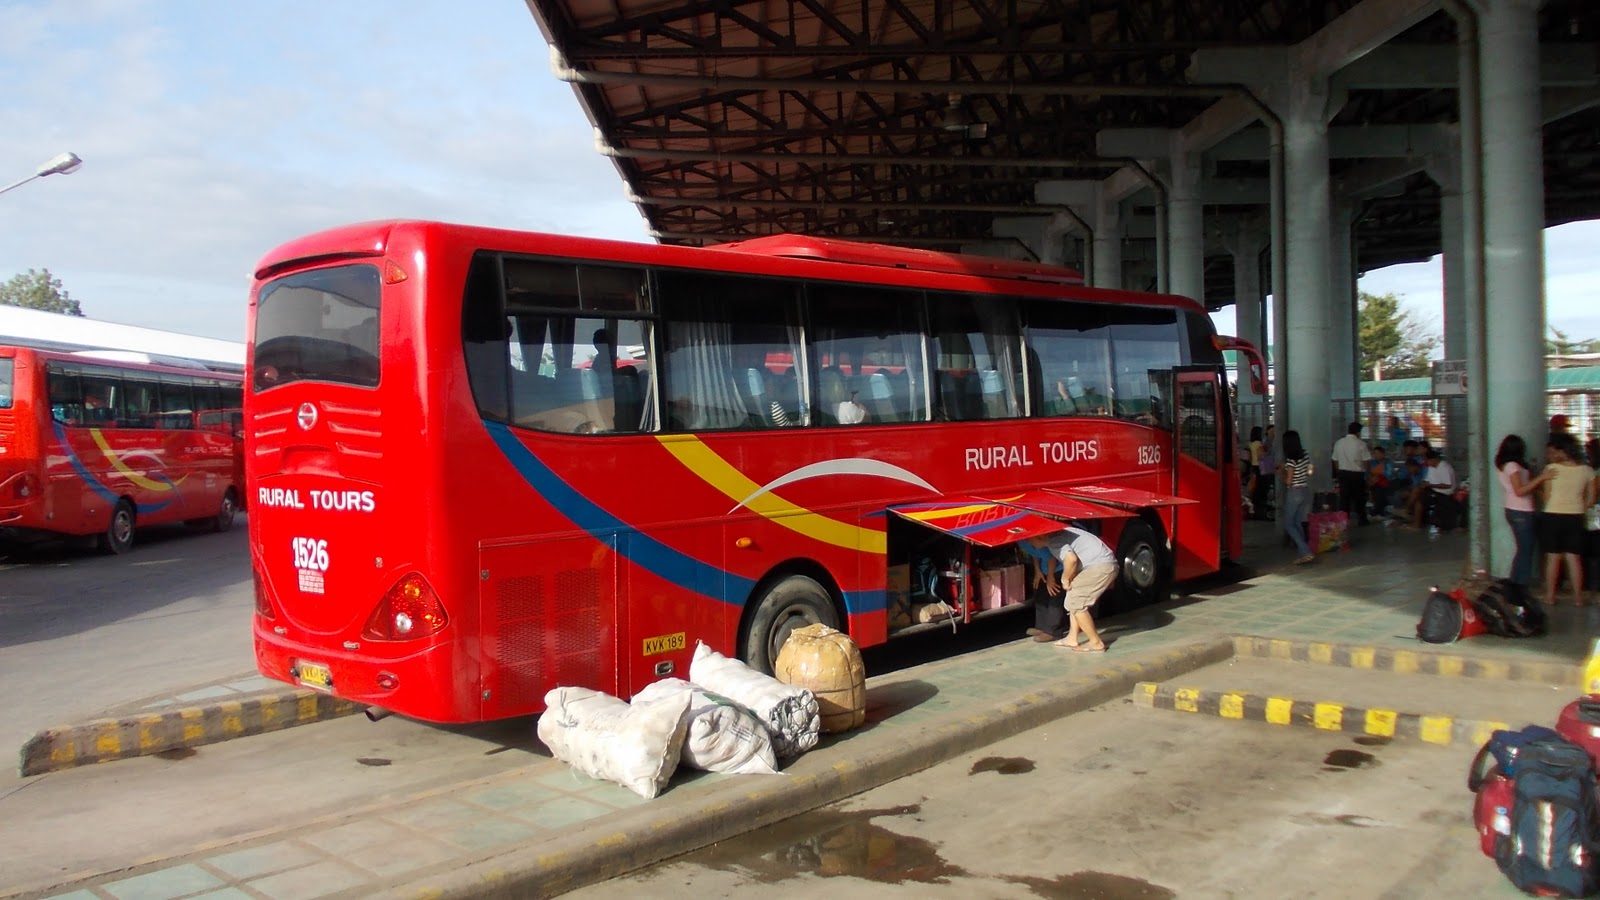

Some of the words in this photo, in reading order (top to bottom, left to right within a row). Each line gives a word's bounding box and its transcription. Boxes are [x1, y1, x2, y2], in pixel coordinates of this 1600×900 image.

[965, 445, 1033, 470] RURAL
[1039, 440, 1098, 464] TOURS
[1137, 445, 1161, 465] 1526
[259, 487, 304, 509] RURAL
[310, 490, 375, 512] TOURS
[292, 536, 329, 571] 1526
[646, 639, 665, 653] KVK
[667, 635, 684, 649] 189
